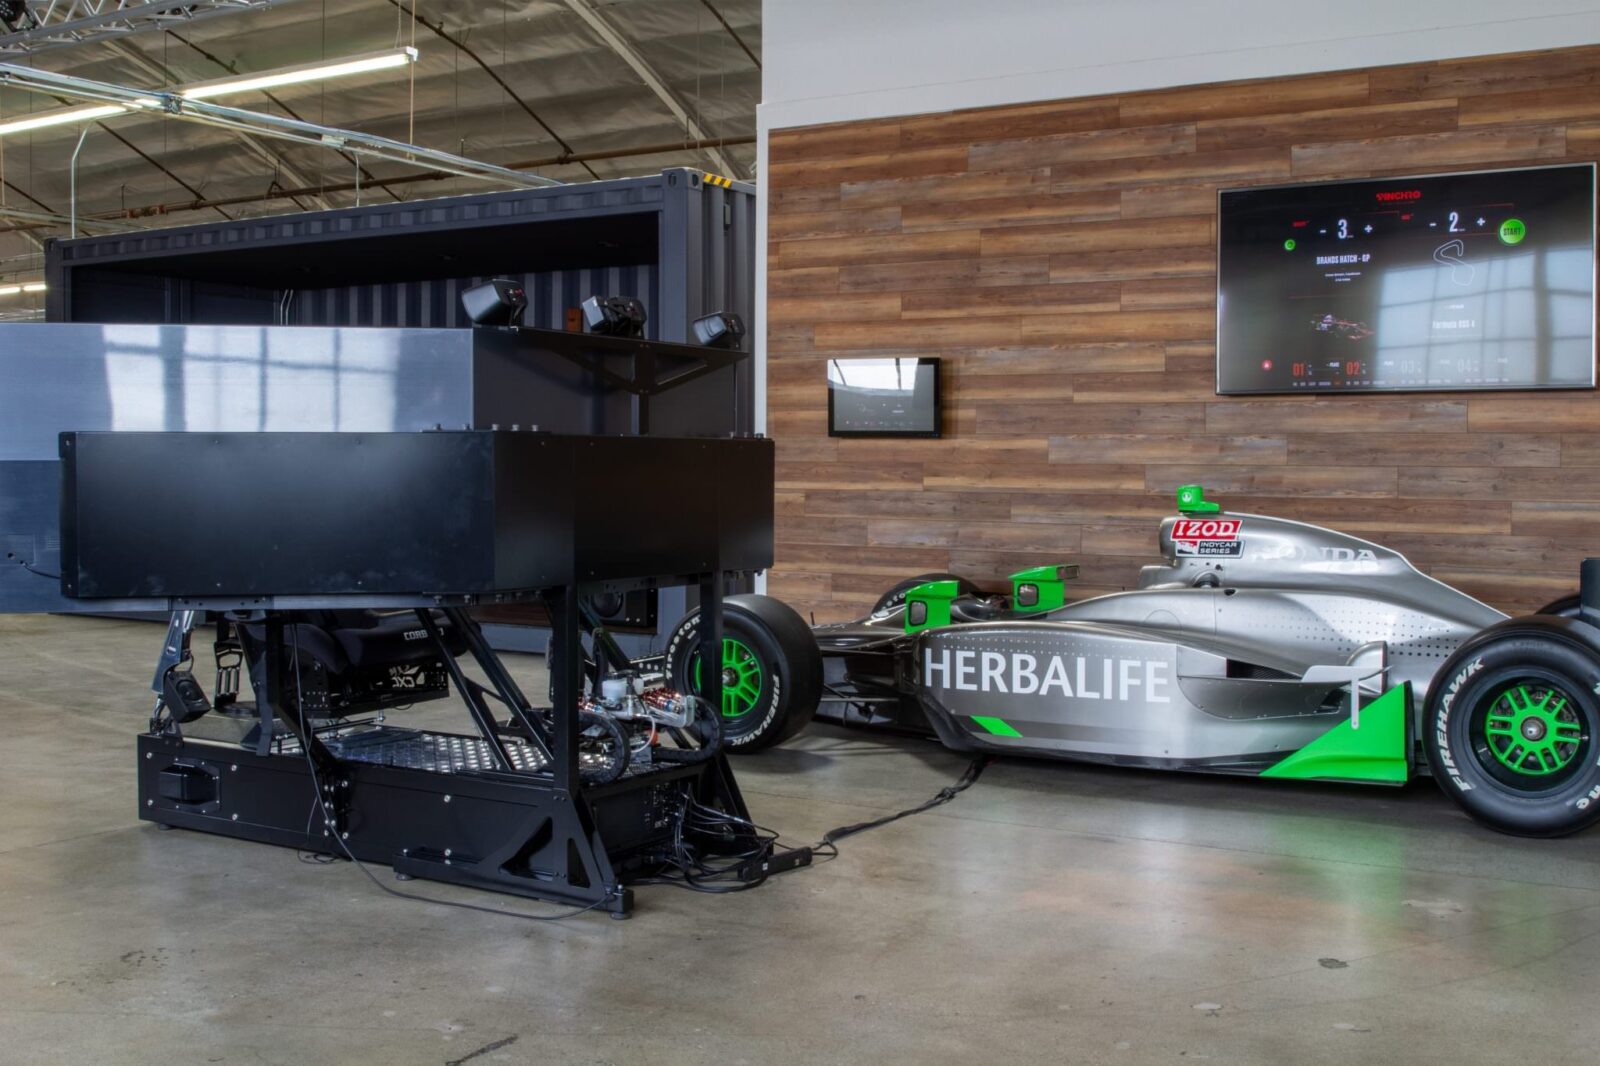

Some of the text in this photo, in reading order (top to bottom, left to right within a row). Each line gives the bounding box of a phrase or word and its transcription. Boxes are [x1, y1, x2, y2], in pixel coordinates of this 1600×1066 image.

[1337, 219, 1347, 238] 3
[1449, 212, 1459, 232] 2
[1503, 227, 1521, 236] START
[1316, 255, 1339, 264] BRANDS
[1340, 254, 1358, 263] HATCH
[1175, 521, 1234, 537] IZOD
[924, 648, 1171, 703] HERBALIFE
[732, 674, 780, 747] FIREHAWK
[1436, 656, 1484, 792] FIREHAWK
